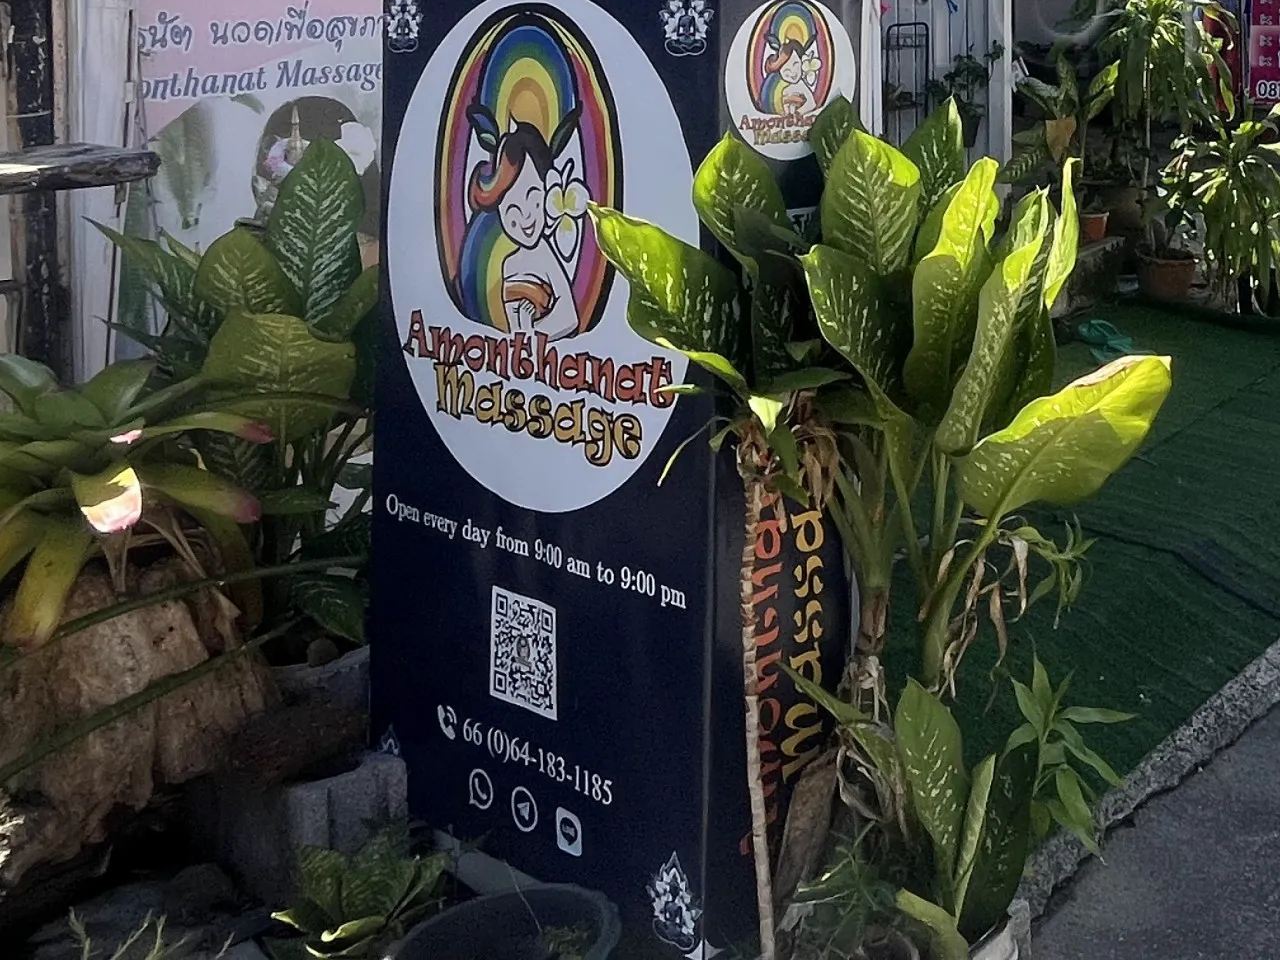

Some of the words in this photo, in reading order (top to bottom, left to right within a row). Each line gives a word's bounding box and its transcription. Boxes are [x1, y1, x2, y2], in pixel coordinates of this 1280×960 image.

[402, 309, 676, 408] Amonthanat
[386, 494, 420, 522] Open
[423, 512, 458, 540] every
[462, 518, 491, 549] day
[495, 526, 530, 557] from
[534, 538, 563, 569] 9:00
[566, 556, 591, 579] am
[596, 561, 615, 585] to
[620, 566, 656, 597] 9:00
[660, 584, 687, 609] pm
[463, 718, 483, 746] 66
[487, 726, 613, 805] (0)64-183-1185
